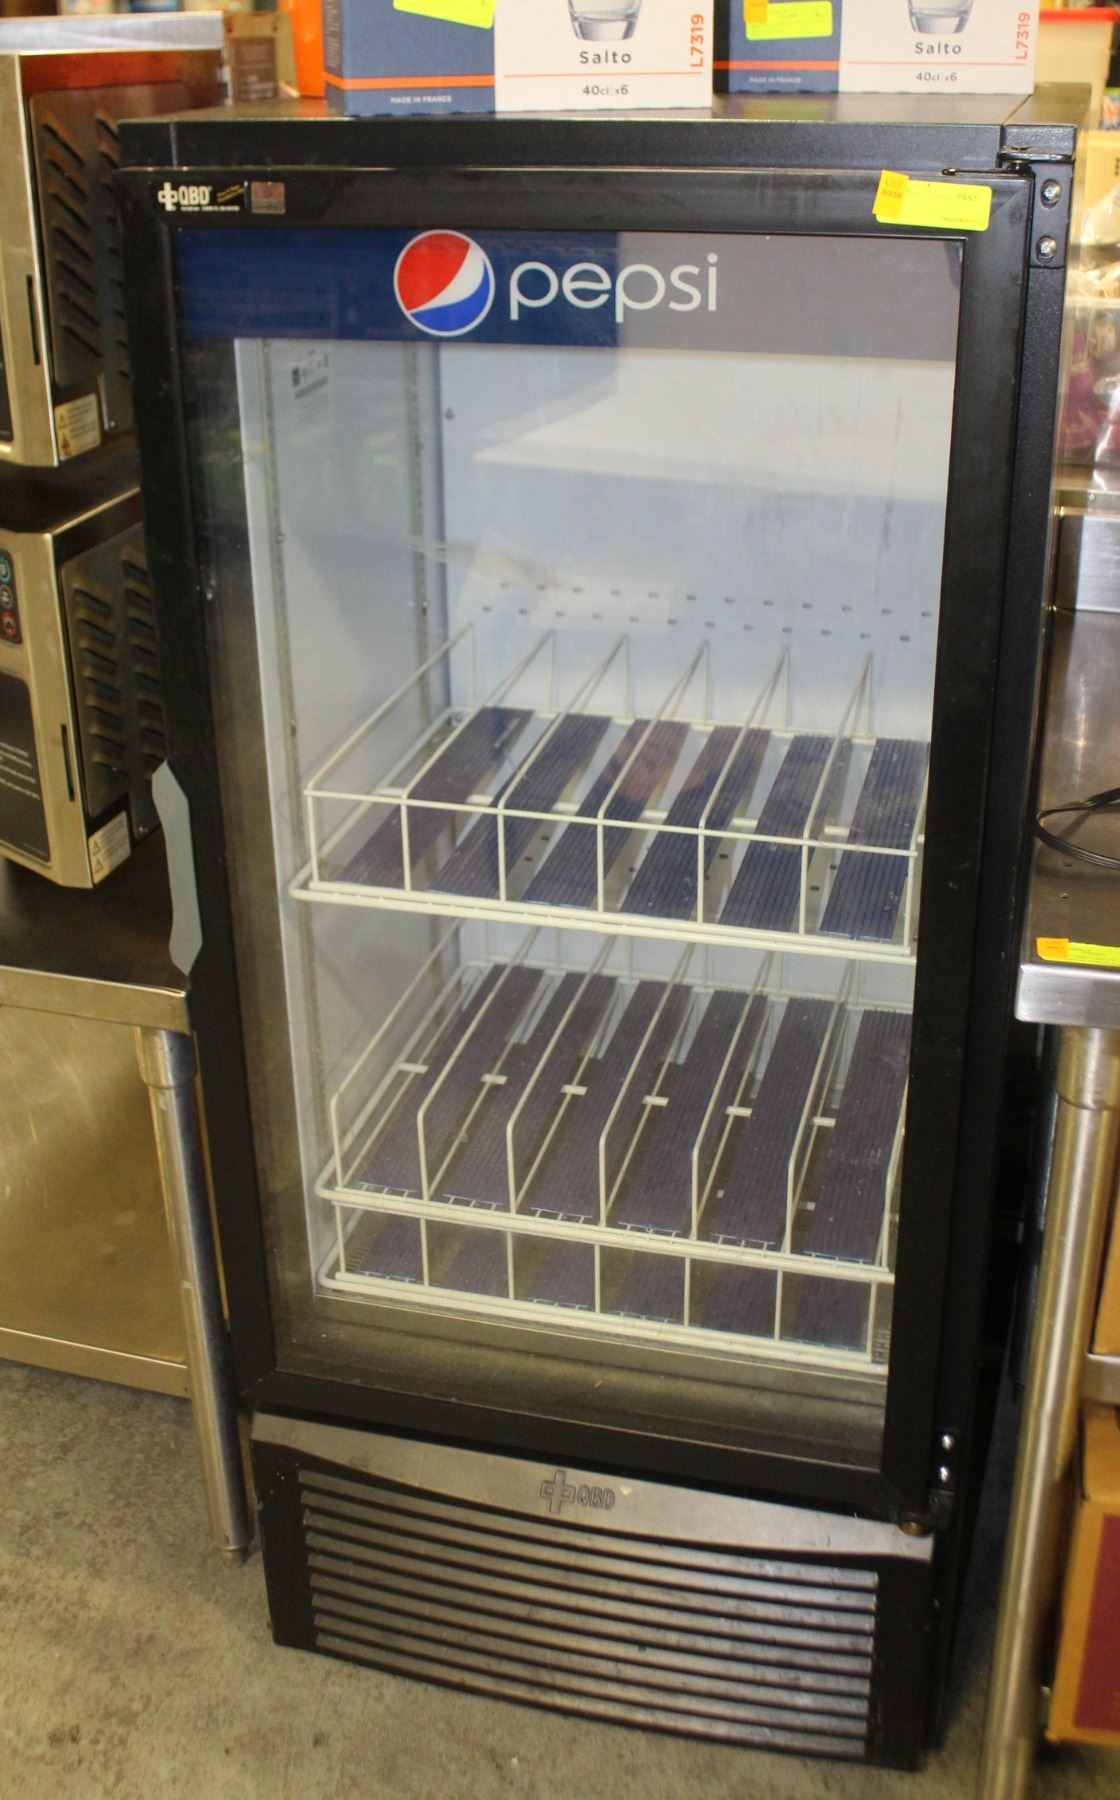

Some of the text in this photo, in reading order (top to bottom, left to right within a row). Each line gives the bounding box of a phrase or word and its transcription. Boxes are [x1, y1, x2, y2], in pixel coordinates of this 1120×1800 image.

[690, 14, 704, 67] L7319
[914, 41, 962, 54] Salto
[1015, 12, 1031, 60] L7319
[579, 50, 632, 64] Salto
[390, 95, 411, 104] MADE
[422, 94, 453, 103] FRANCE
[178, 185, 211, 206] QBD
[509, 252, 718, 323] pepsi
[576, 1484, 616, 1511] QBD
